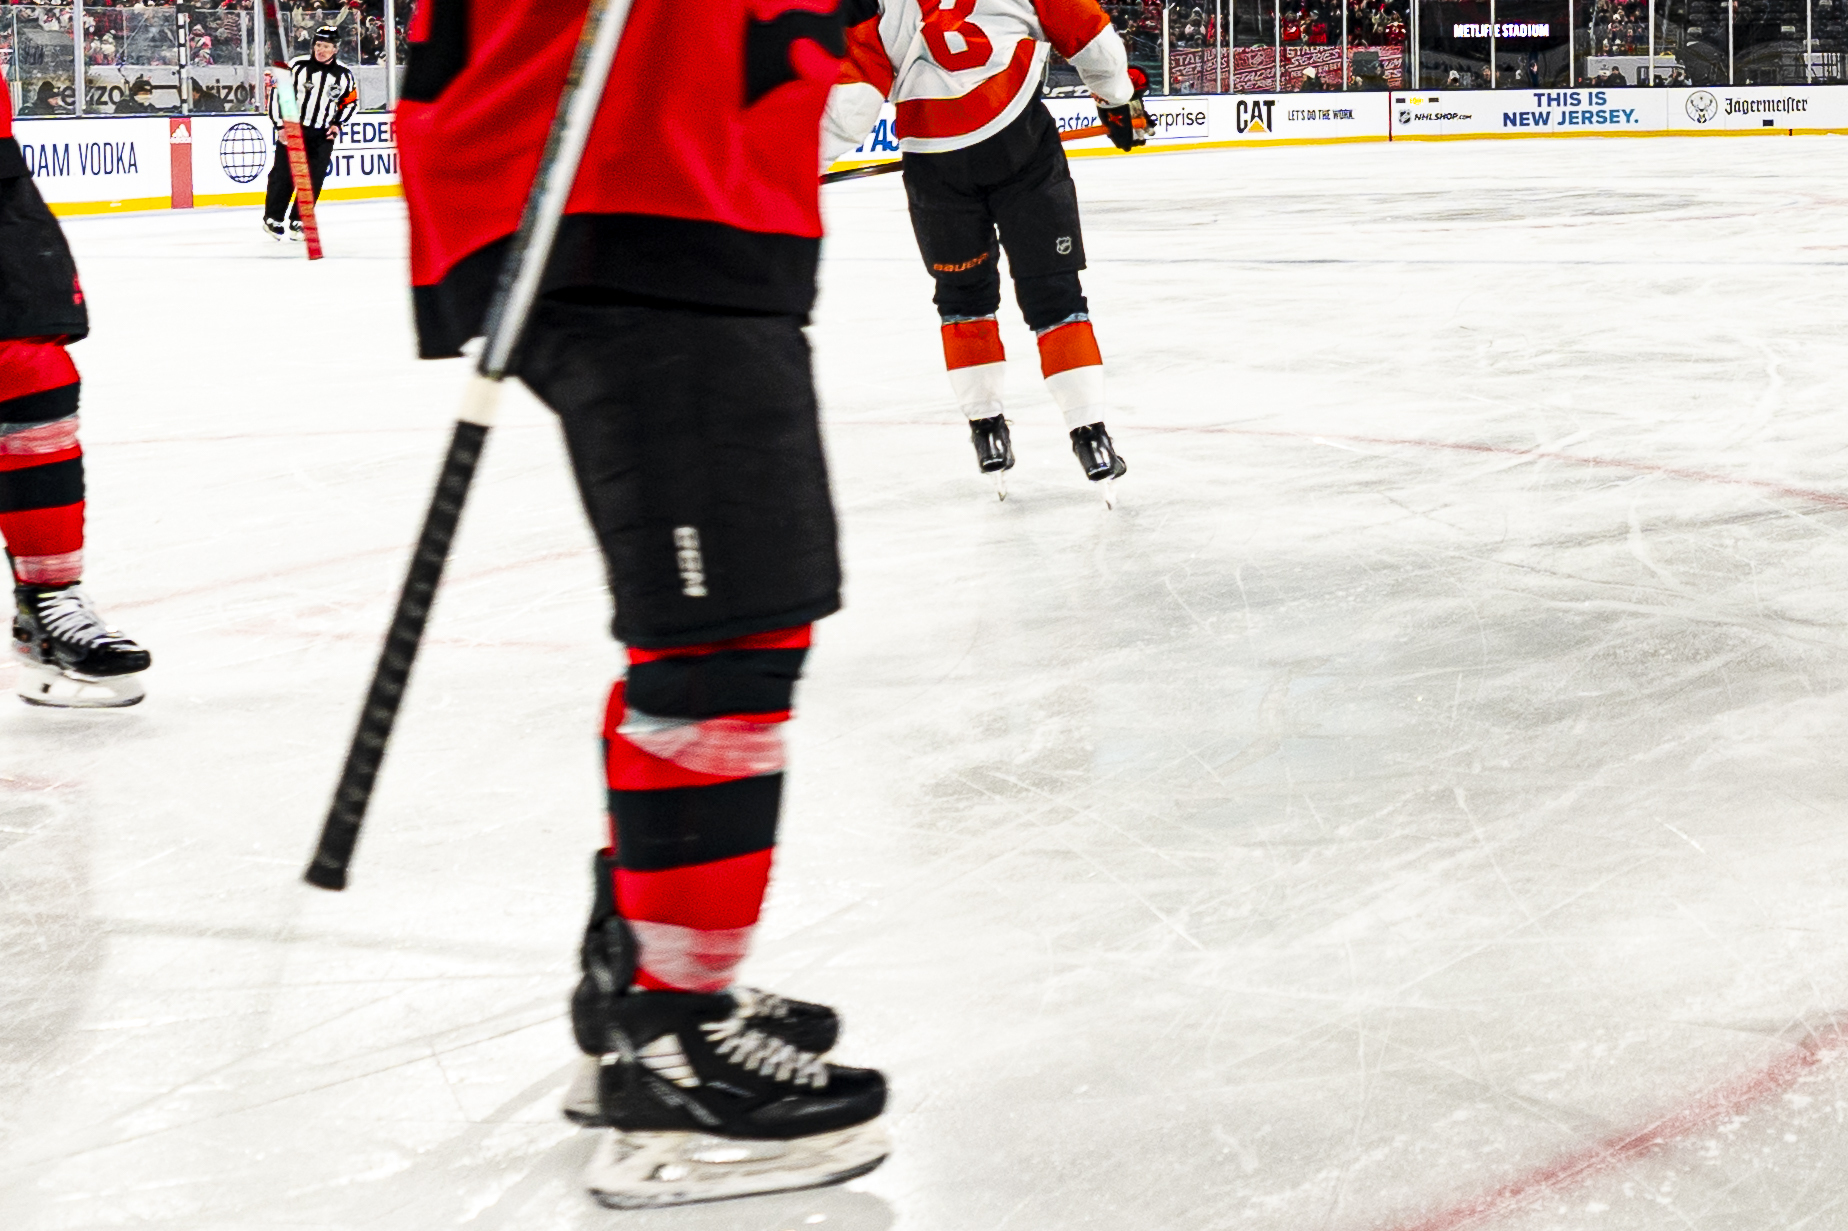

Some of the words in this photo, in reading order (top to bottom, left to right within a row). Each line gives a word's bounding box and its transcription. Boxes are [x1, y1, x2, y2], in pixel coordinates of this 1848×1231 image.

[1502, 24, 1550, 38] STADIUM
[1533, 92, 1581, 108] THIS
[1588, 91, 1607, 107] IS
[1057, 113, 1097, 134] aster
[1149, 109, 1206, 134] erprise
[1236, 100, 1275, 133] CAT
[1318, 109, 1331, 120] THE
[1503, 111, 1550, 128] NEW
[1557, 109, 1639, 127] JERSEY.
[78, 142, 139, 176] VODKA
